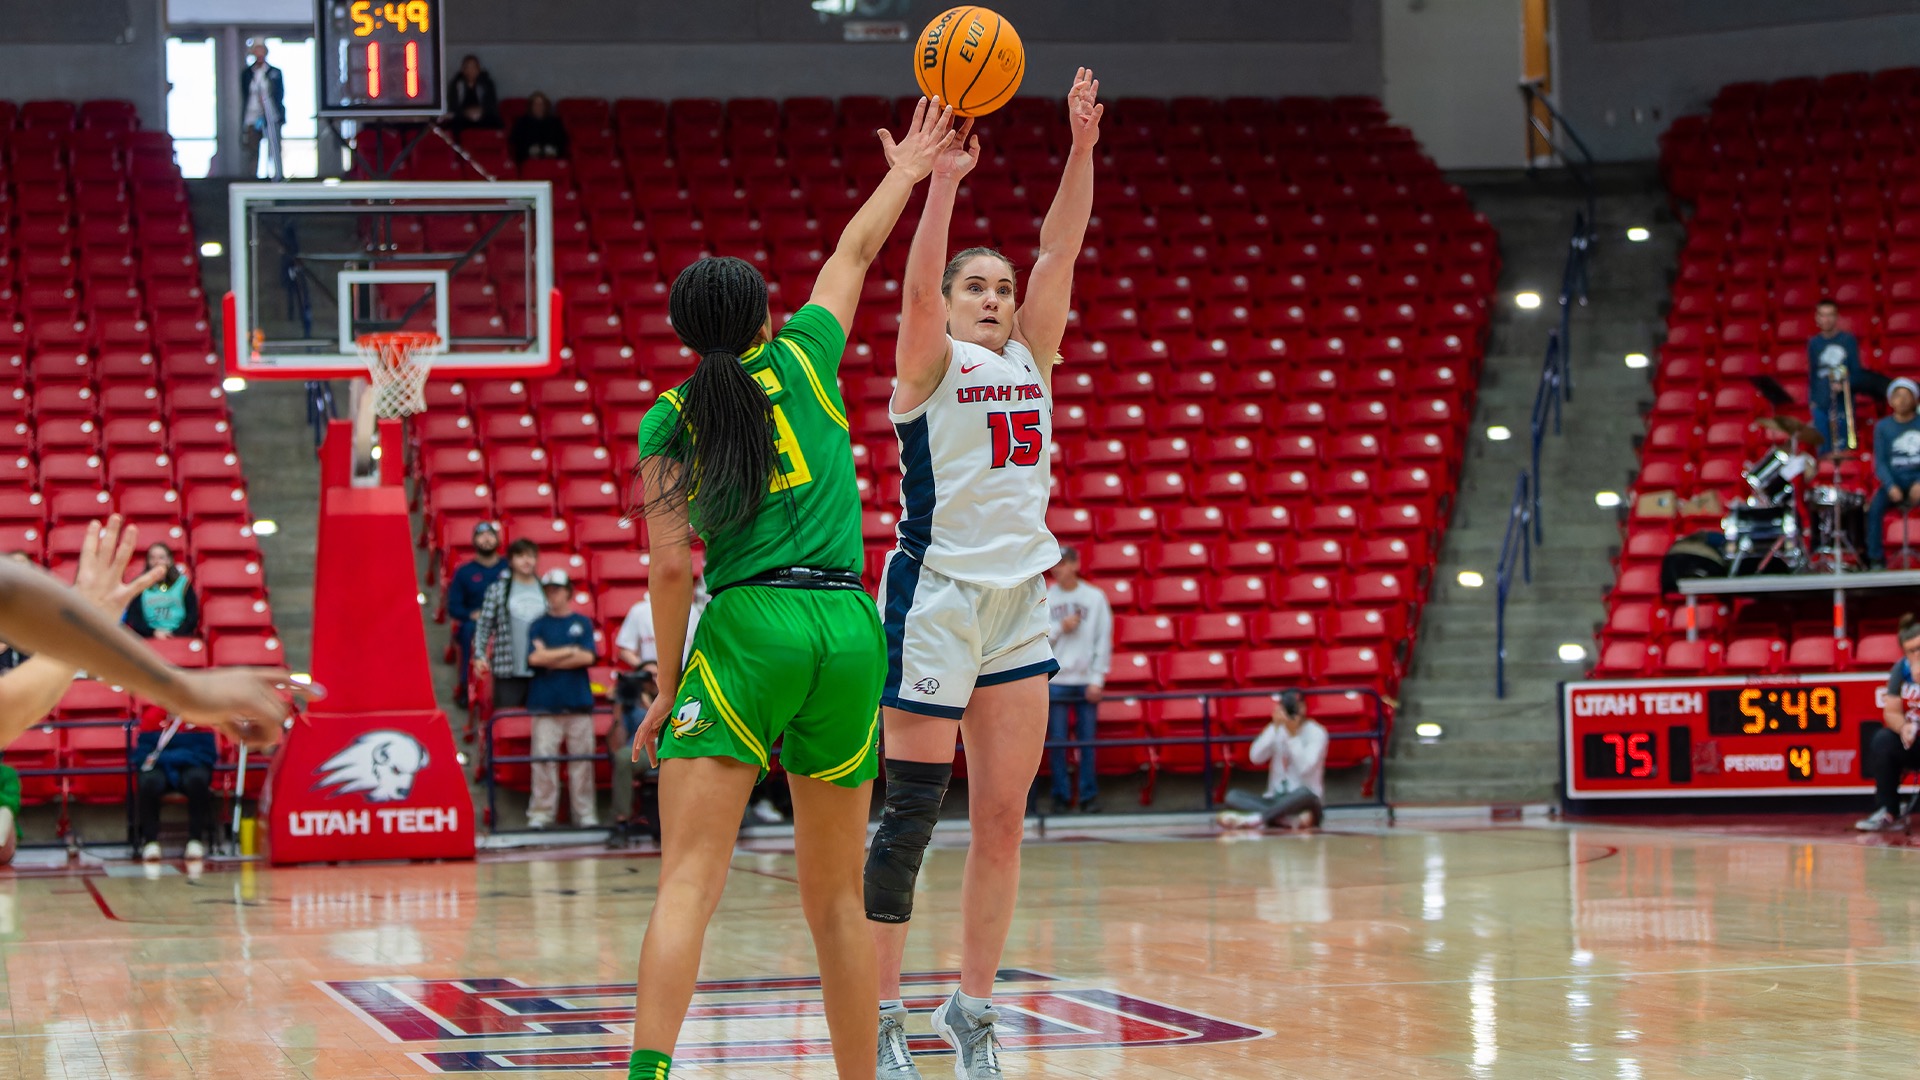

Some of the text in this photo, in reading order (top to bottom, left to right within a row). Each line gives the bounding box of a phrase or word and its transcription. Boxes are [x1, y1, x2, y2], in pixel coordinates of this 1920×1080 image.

[351, 0, 429, 36] 5:49
[924, 8, 960, 70] Wilson
[960, 20, 985, 63] EVO
[367, 41, 419, 98] 11
[957, 383, 1043, 404] UTAH TEC
[987, 409, 1043, 469] 15
[1575, 691, 1702, 716] UTAH TECH
[1739, 687, 1837, 734] 5:49
[1603, 733, 1653, 777] 75
[1724, 748, 1811, 777] PERIOD 4
[289, 807, 458, 836] UTAH TECH
